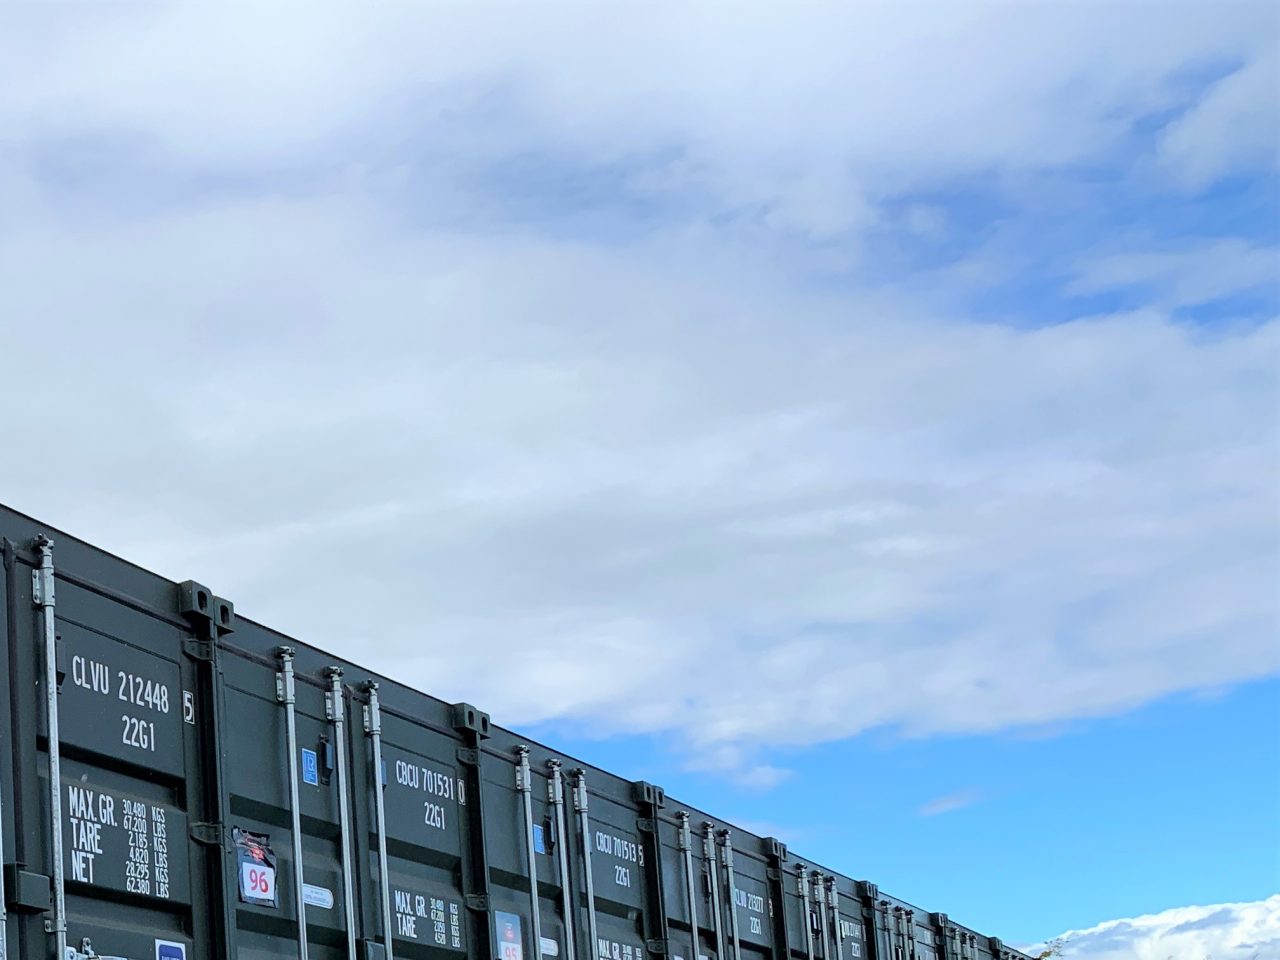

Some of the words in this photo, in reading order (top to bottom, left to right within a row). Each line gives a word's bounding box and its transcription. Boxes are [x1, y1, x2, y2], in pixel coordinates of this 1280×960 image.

[72, 655, 109, 695] CLVU
[118, 671, 169, 714] 212448
[185, 694, 193, 721] 5
[122, 715, 155, 752] 22G1
[396, 759, 419, 789] CBCU
[421, 768, 454, 800] 701531
[151, 806, 165, 823] KGS
[424, 802, 445, 830] 22G1
[70, 818, 103, 854] TARE
[152, 822, 166, 838] LBS
[153, 836, 167, 852] KGS
[71, 850, 94, 883] NET
[154, 852, 168, 868] LBS
[155, 867, 168, 882] KGS
[249, 869, 269, 893] 96
[156, 882, 169, 898] LBS
[396, 913, 418, 938] TARE
